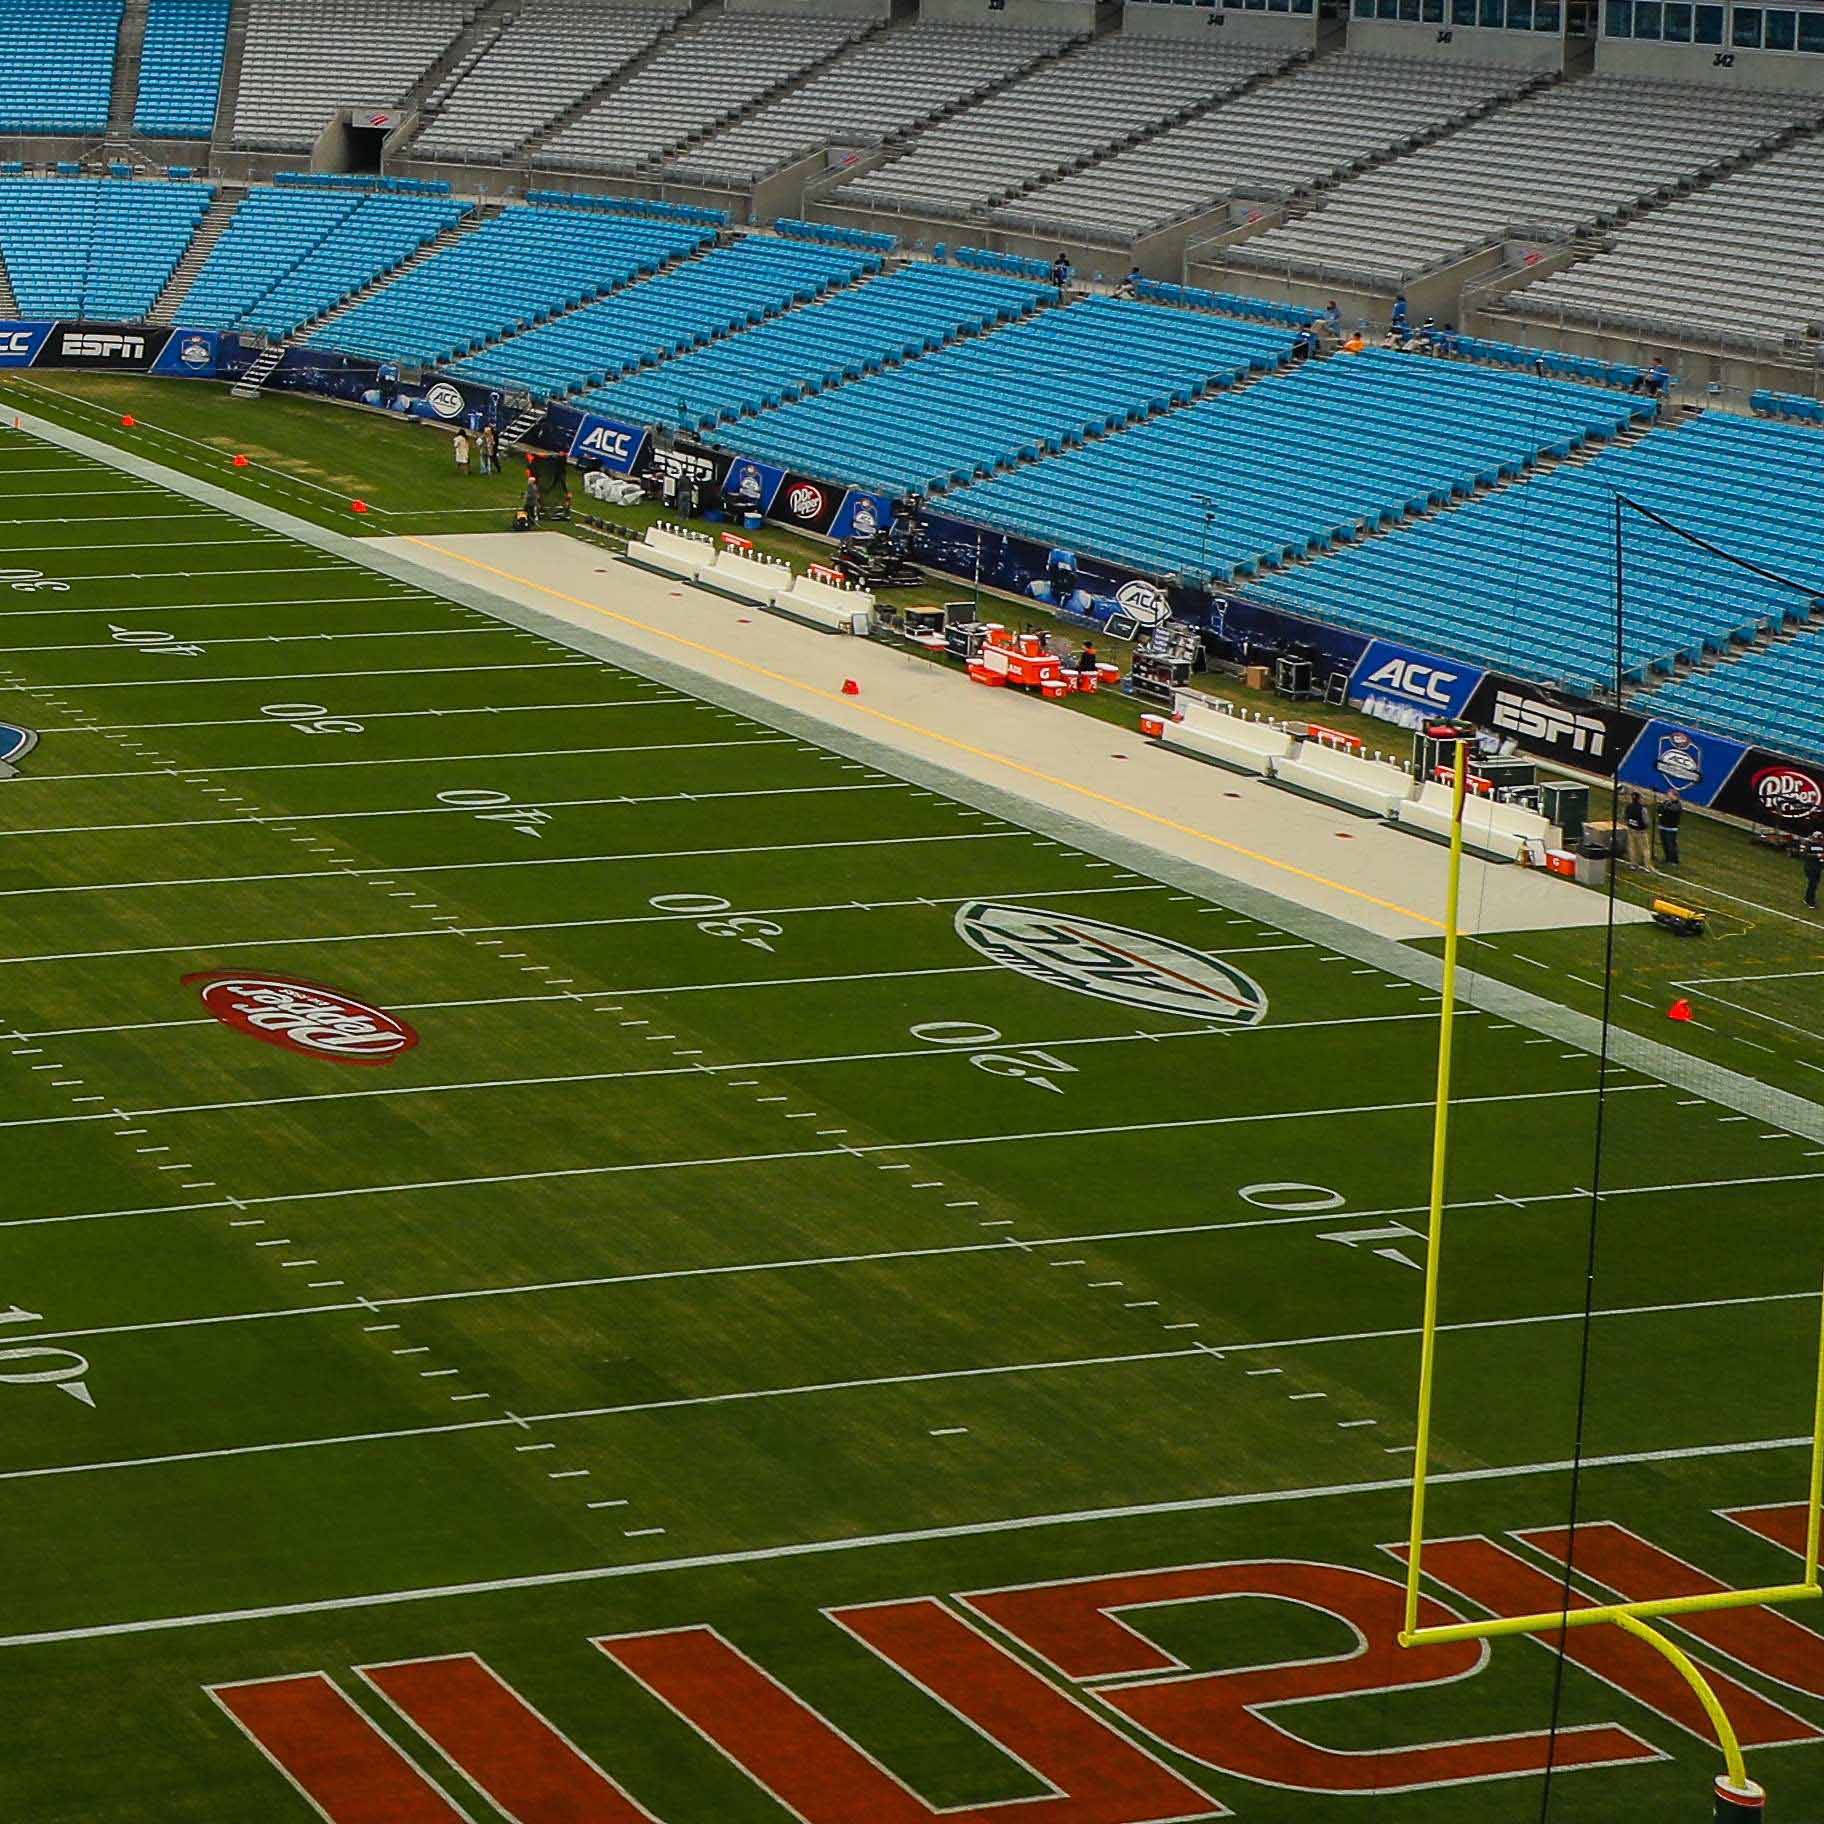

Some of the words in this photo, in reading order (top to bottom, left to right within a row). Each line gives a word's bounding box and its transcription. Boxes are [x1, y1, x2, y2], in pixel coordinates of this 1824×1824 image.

[61, 333, 145, 359] ESPN
[432, 390, 459, 408] ACC
[581, 427, 632, 457] ACC
[1127, 589, 1160, 610] ACC
[110, 628, 207, 657] 40
[1366, 658, 1459, 704] ACC
[258, 702, 366, 735] 50
[1492, 690, 1608, 757] ESPN
[1782, 776, 1804, 792] Dr
[435, 788, 554, 828] 40
[646, 892, 785, 939] 30
[965, 920, 1220, 1003] ACC
[226, 985, 408, 1054] Pepper
[230, 1002, 306, 1031] Dr
[906, 1020, 1081, 1079] 20
[1237, 1181, 1432, 1249] 10
